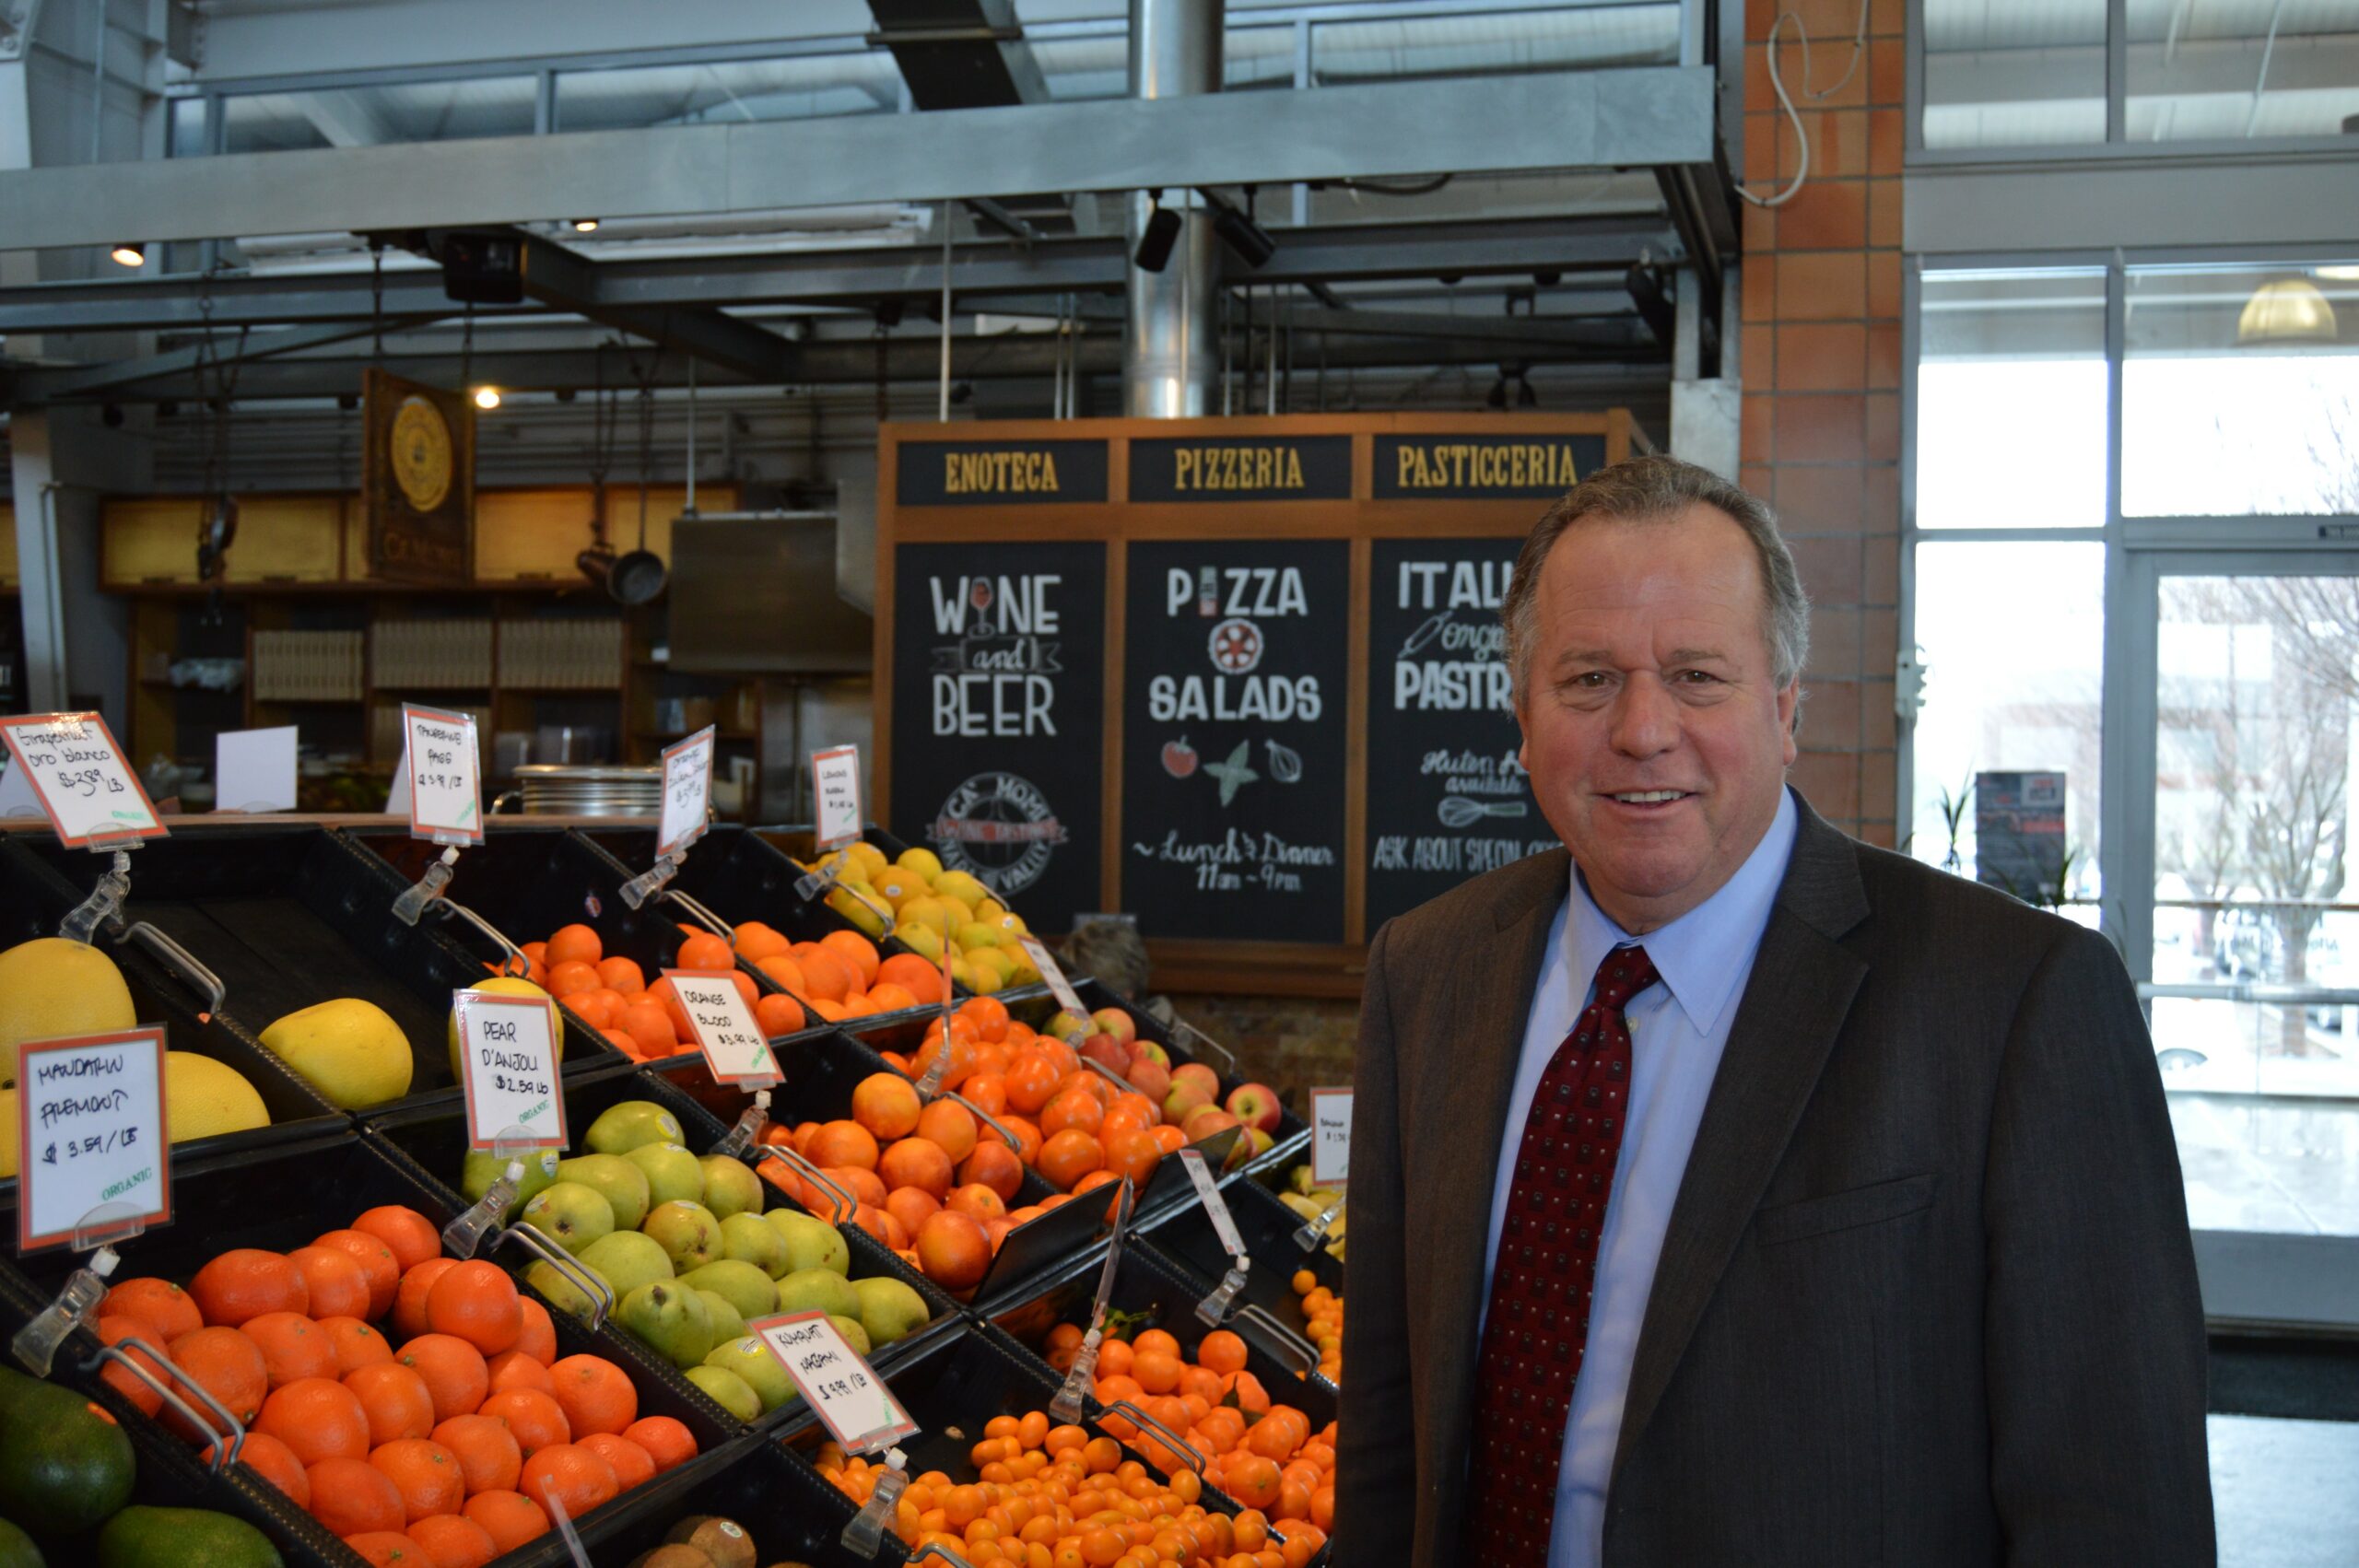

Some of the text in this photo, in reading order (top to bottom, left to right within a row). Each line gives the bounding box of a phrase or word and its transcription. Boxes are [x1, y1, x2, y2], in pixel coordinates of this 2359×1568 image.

[945, 451, 1059, 493] ENOTECA
[1174, 446, 1305, 490] PIZZERIA
[1397, 443, 1579, 488] PASTICCERIA
[1167, 566, 1309, 617] PIZZA
[1398, 560, 1514, 610] ITALI
[930, 574, 1062, 636] WINE
[972, 638, 1026, 670] and
[1149, 674, 1322, 721] SALADS
[1394, 660, 1514, 710] PASTR
[933, 673, 1057, 736] BEER
[1158, 827, 1243, 863] Lunch
[1262, 831, 1334, 865] Dinner
[1373, 836, 1409, 872] ASK
[1412, 837, 1465, 872] ABOUT
[684, 989, 726, 1006] ORANGE
[483, 1020, 517, 1043] PEAR
[697, 1012, 732, 1027] BLOOD
[38, 1055, 124, 1086] MANDARIN
[481, 1048, 539, 1072] D'ANJOU
[495, 1074, 534, 1095] $2.59
[518, 1099, 551, 1124] ORGANIC
[101, 1166, 153, 1201] ORGANIC
